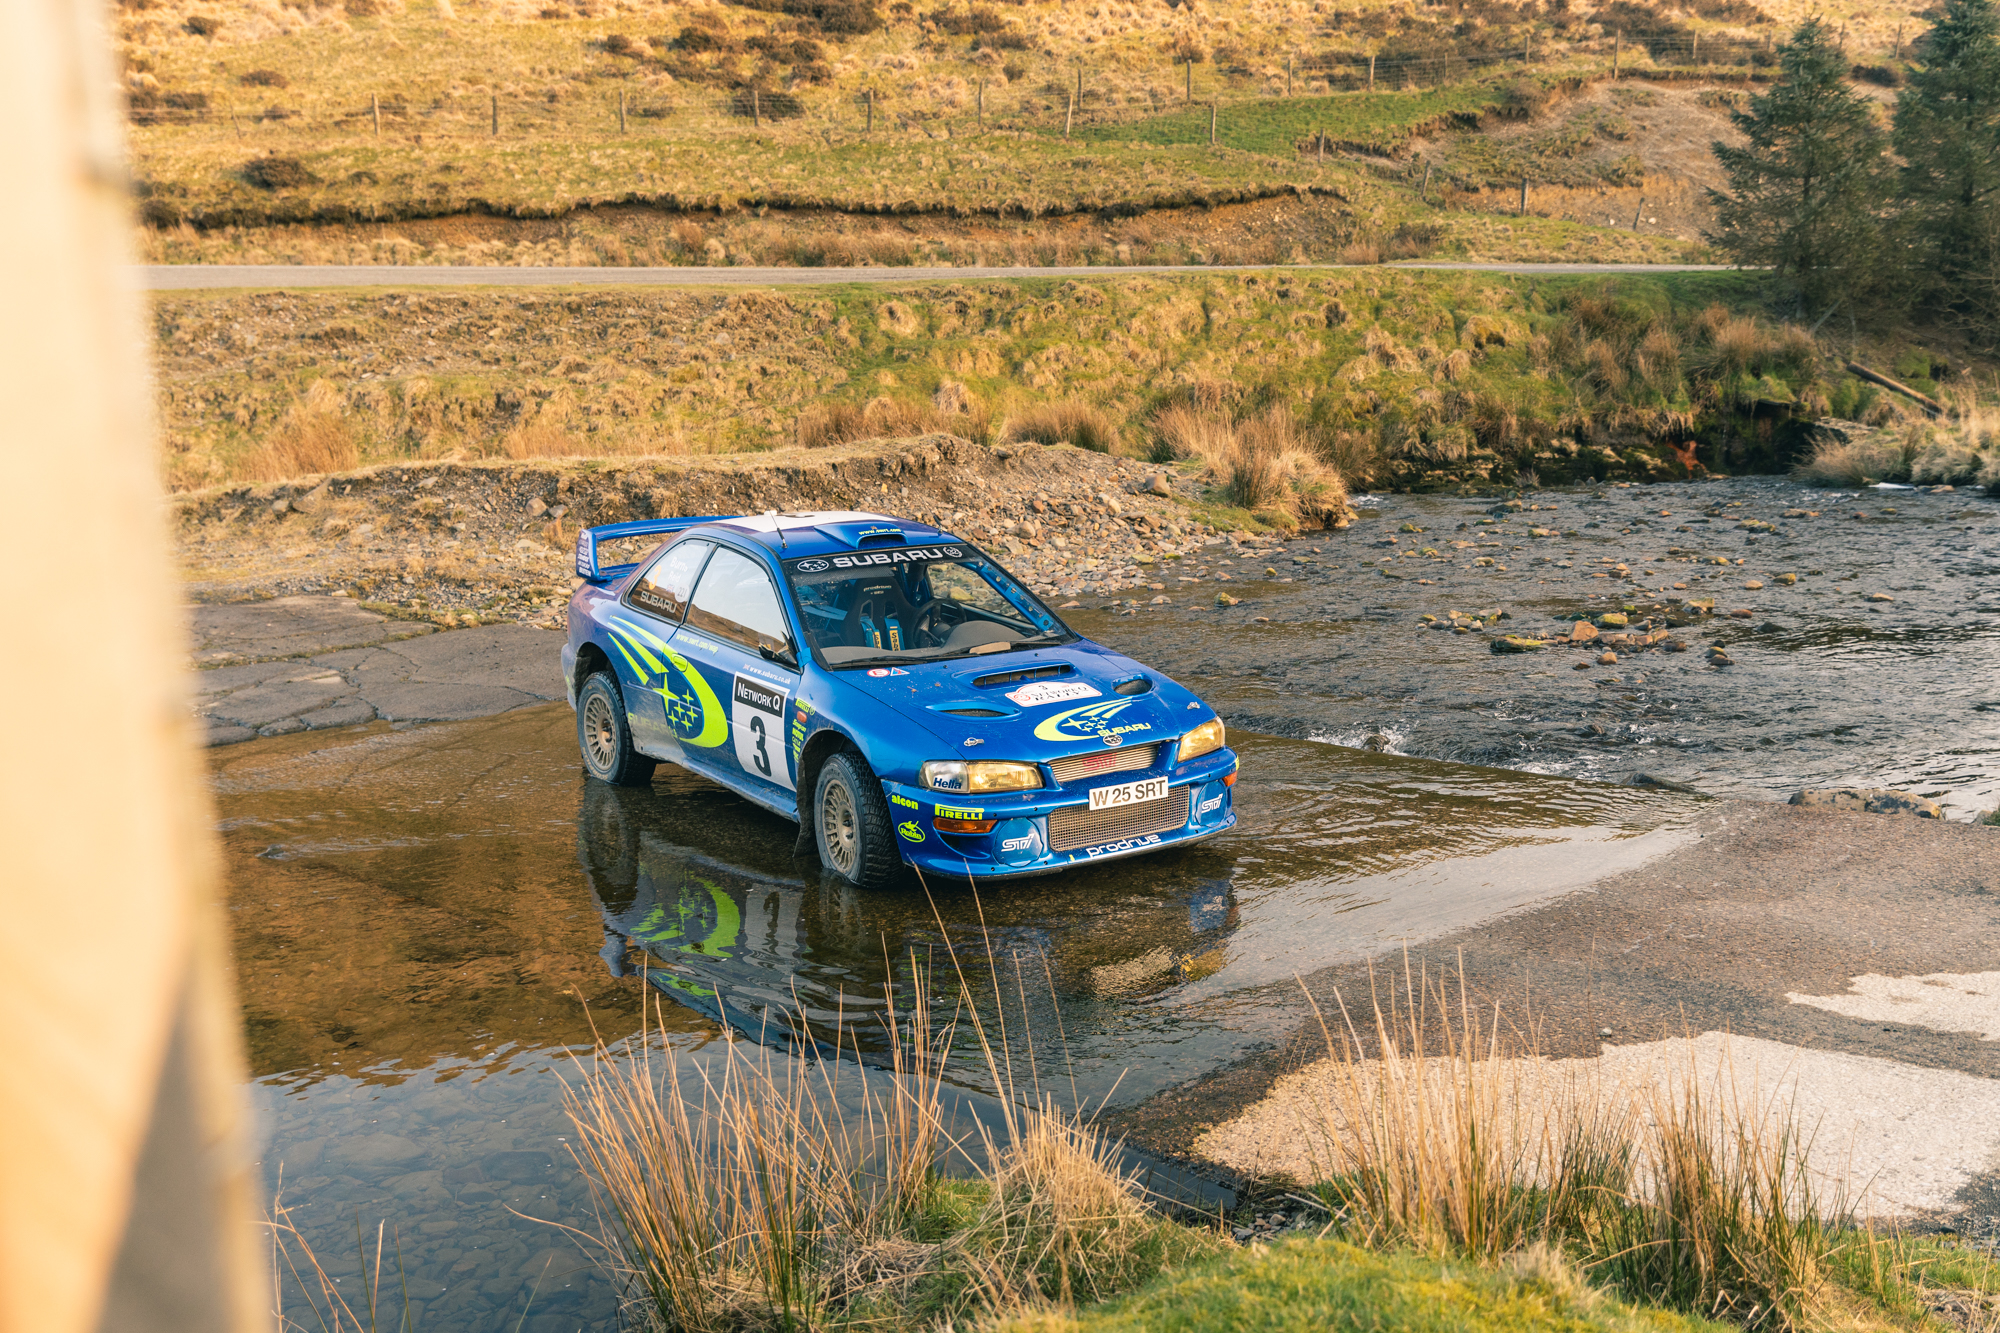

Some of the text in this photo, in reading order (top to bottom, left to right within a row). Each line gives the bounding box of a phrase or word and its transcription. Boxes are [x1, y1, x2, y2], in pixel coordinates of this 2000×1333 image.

[670, 556, 688, 572] Burns
[833, 548, 943, 568] SUBARU
[648, 564, 662, 590] 3
[640, 590, 678, 613] SUBARU
[749, 666, 792, 685] www.subaru.co.uk
[737, 682, 780, 711] NETWORK Q
[1097, 722, 1152, 737] SUBARU
[750, 715, 772, 777] 3
[933, 777, 962, 790] Hella
[1092, 779, 1166, 807] W 25 SRT
[891, 794, 919, 811] alcon
[934, 803, 985, 820] PIRELLI
[900, 827, 922, 840] Robin
[1085, 834, 1162, 859] prodrive
